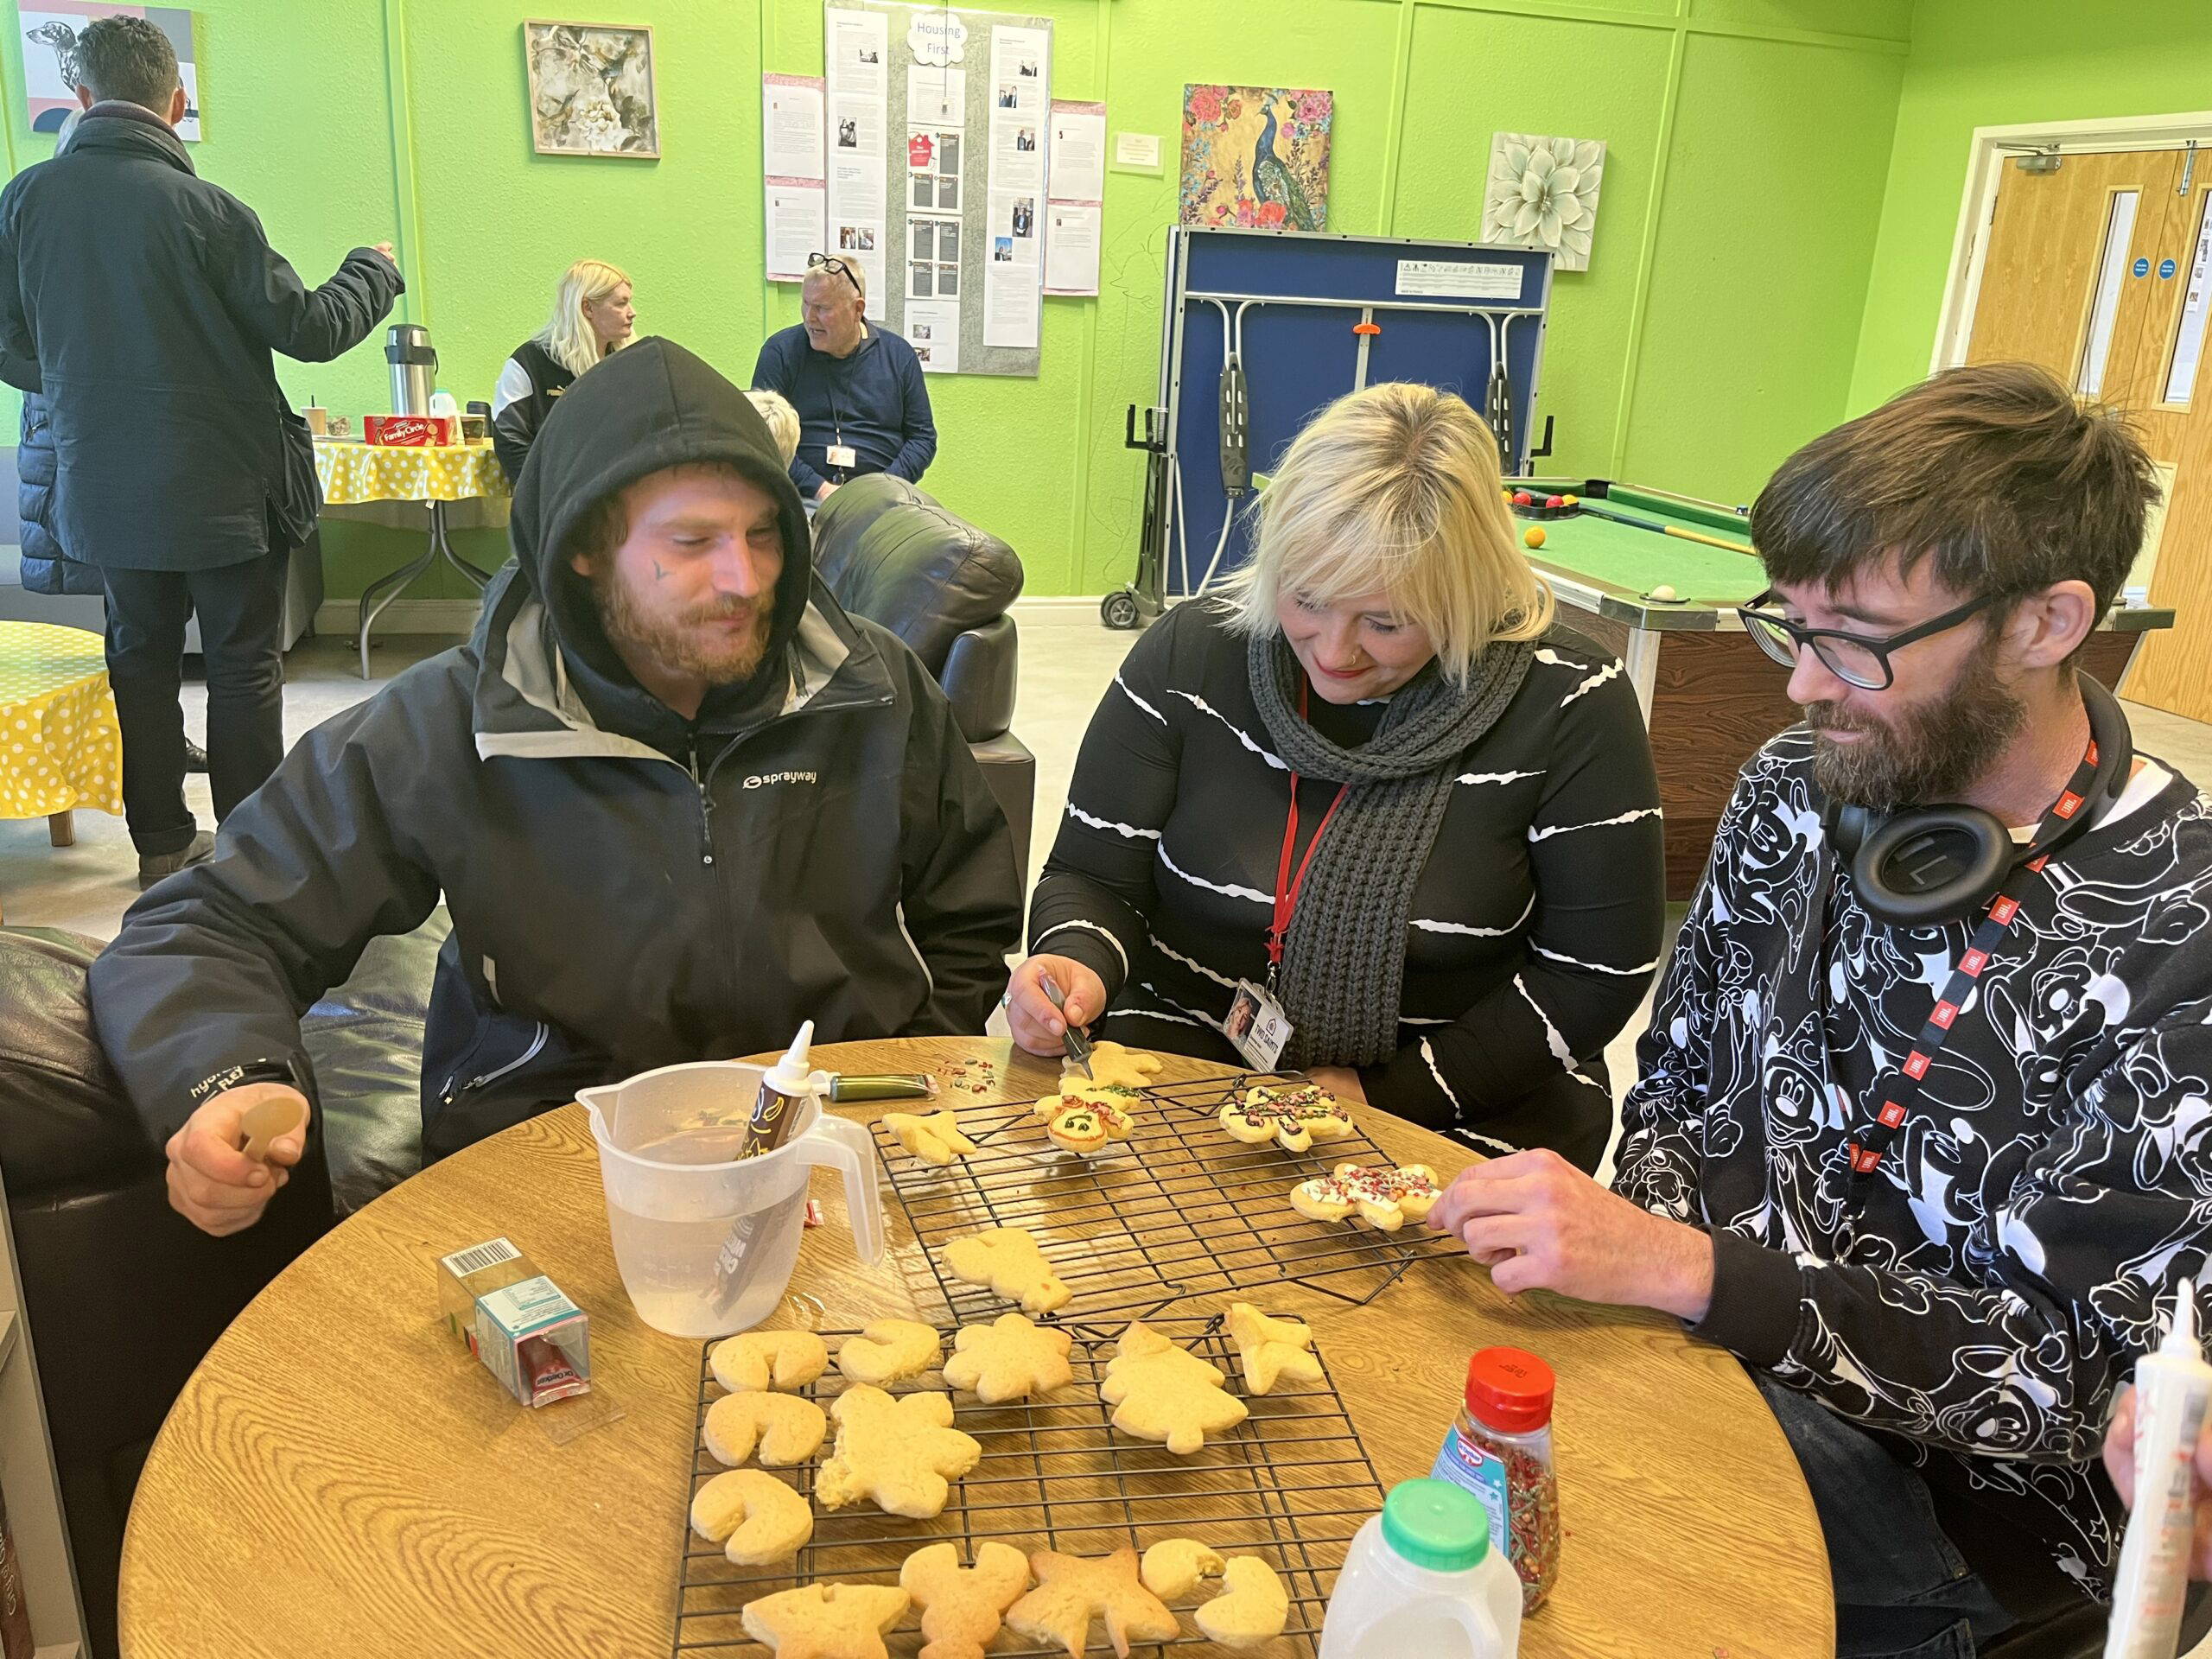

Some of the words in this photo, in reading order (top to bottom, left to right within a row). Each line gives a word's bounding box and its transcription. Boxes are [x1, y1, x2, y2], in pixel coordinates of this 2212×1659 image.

[917, 22, 961, 39] Housing
[927, 42, 950, 55] First
[384, 427, 406, 442] Family
[405, 423, 424, 434] Circle
[762, 772, 817, 785] sprayway
[1995, 903, 2012, 918] JBL
[1966, 955, 1981, 970] JBL
[1936, 1007, 1953, 1023] JBL
[1255, 1023, 1266, 1039] TWO
[1263, 1033, 1279, 1054] SAINTS
[1910, 1058, 1924, 1074] JBL
[1885, 1109, 1899, 1122] JBL
